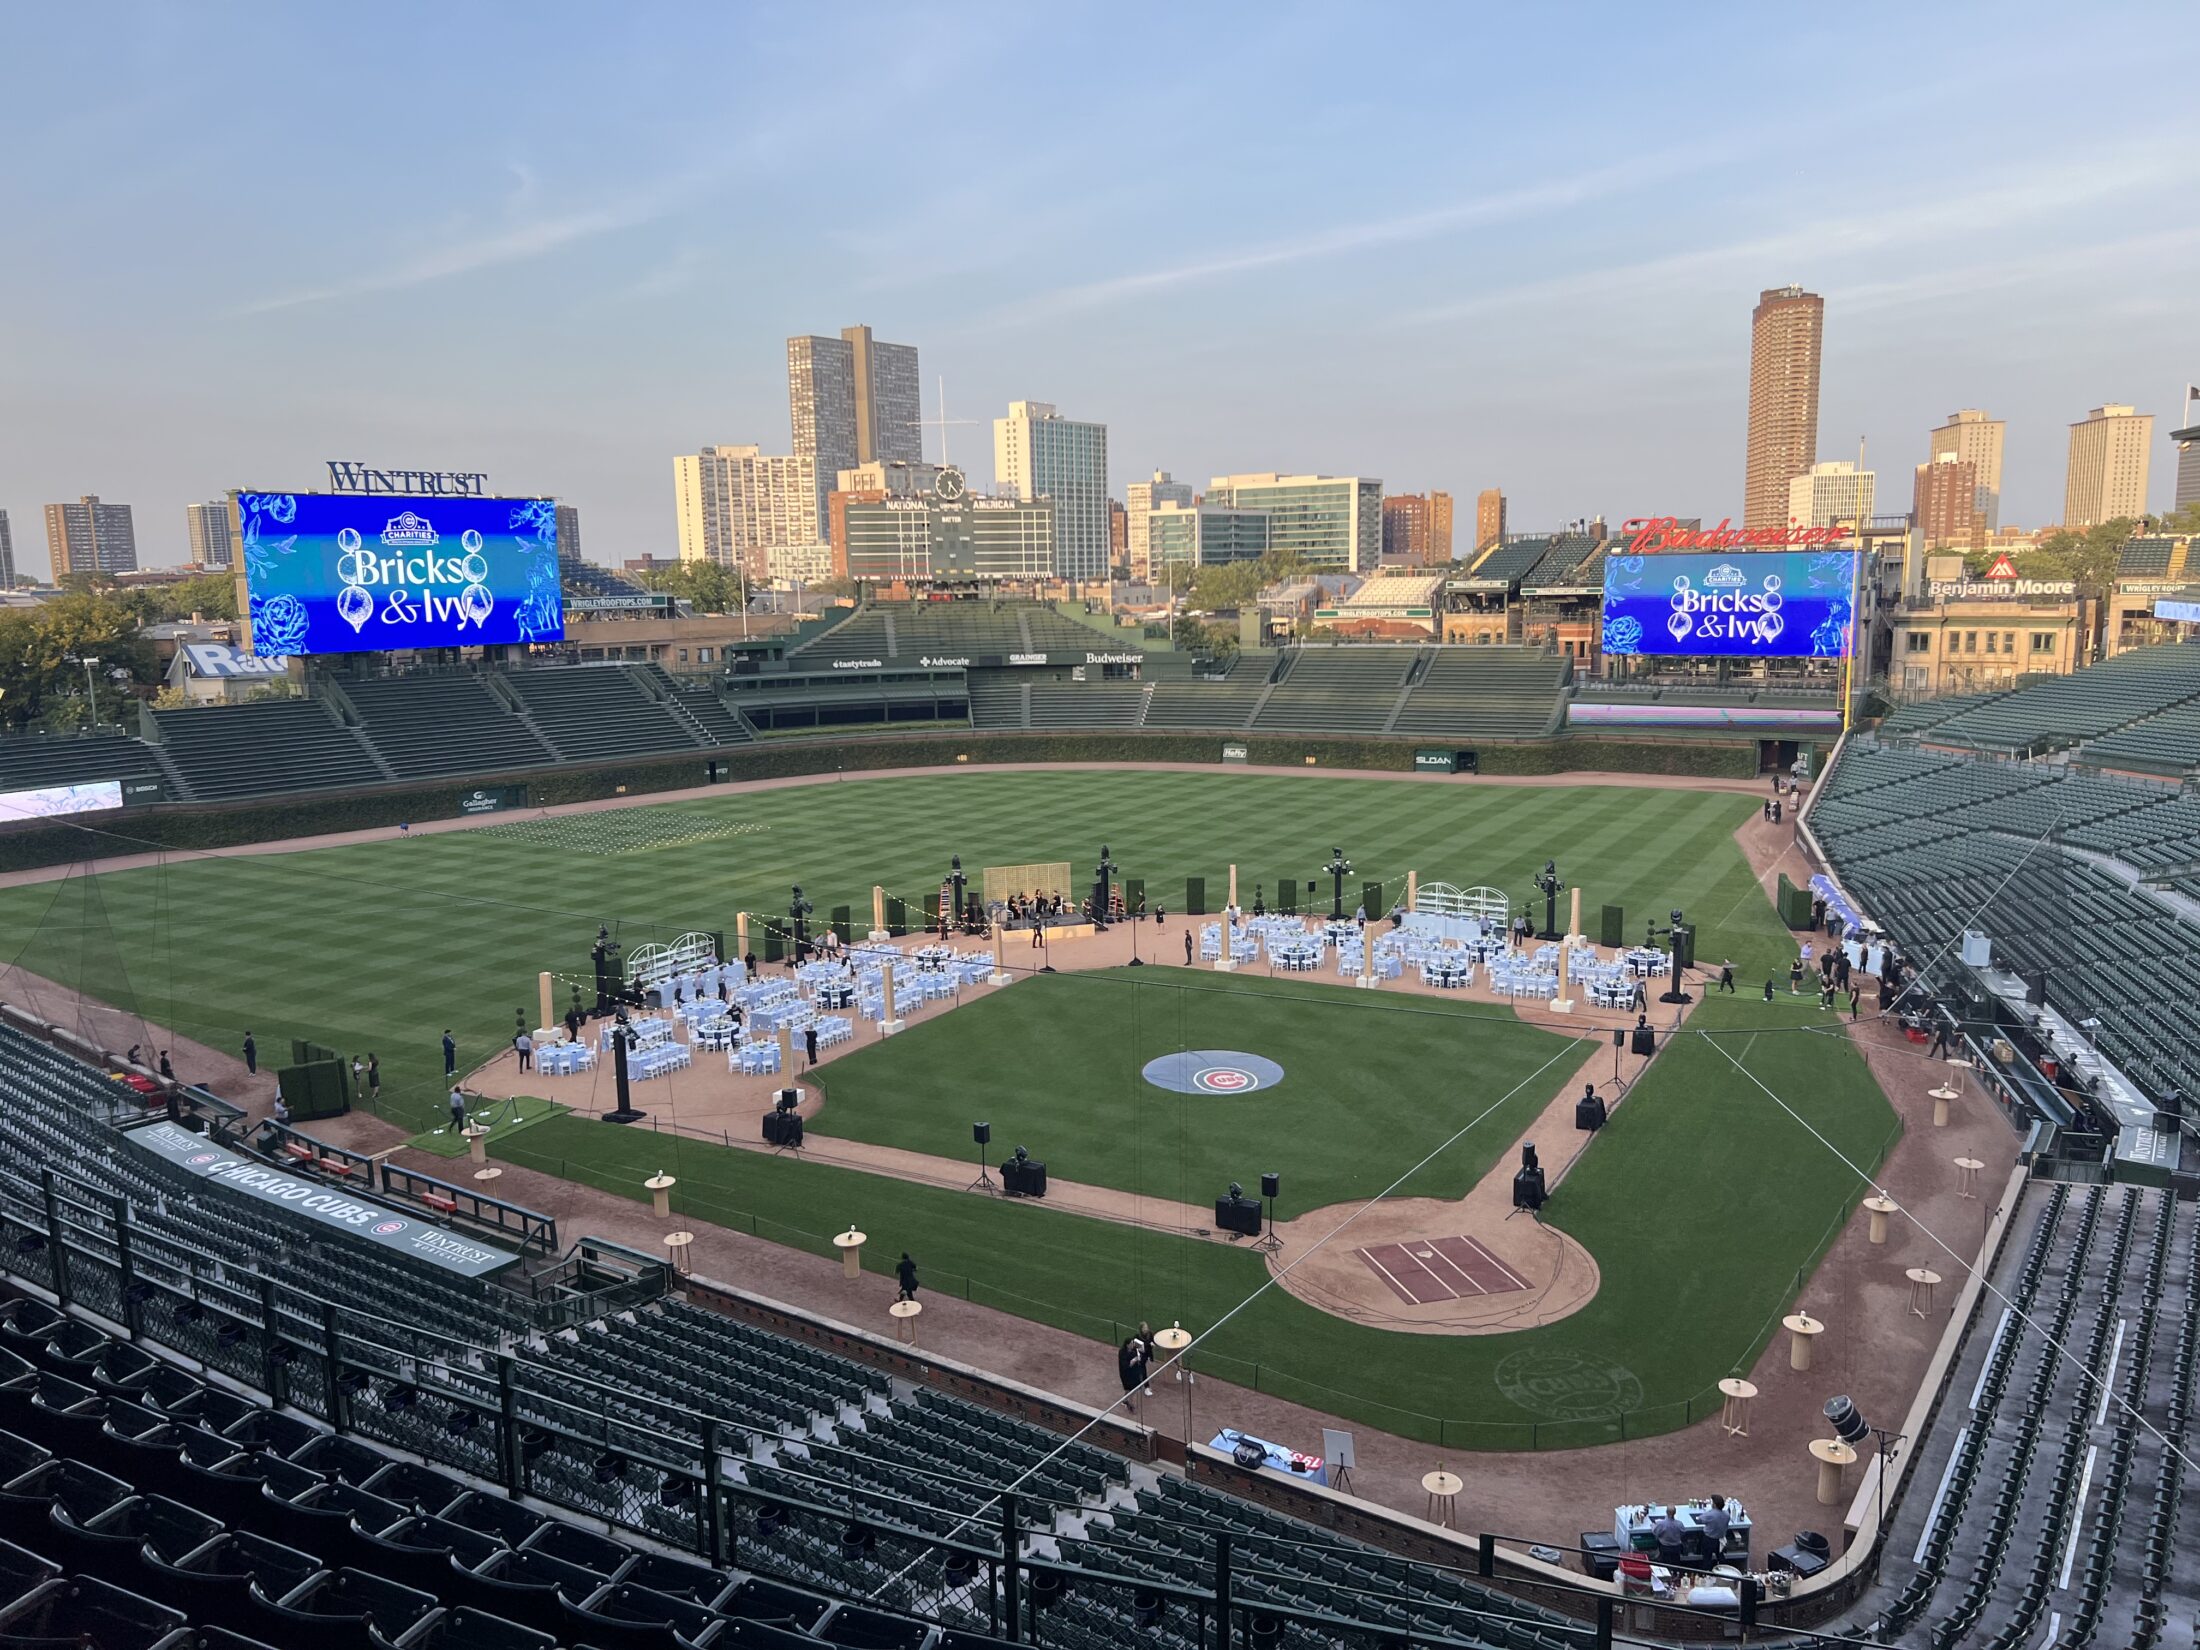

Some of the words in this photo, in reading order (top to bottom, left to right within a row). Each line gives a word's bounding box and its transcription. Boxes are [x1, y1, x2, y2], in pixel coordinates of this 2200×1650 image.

[326, 461, 488, 496] WINTRUST
[886, 500, 930, 510] NATIONAL
[973, 500, 1015, 510] AMERICAN
[387, 531, 432, 539] CHARITIES
[1621, 516, 1852, 553] Budweiser
[354, 549, 465, 585] Bricks
[1930, 579, 2011, 598] Benjamin
[2015, 579, 2074, 595] Moore
[570, 597, 653, 608] WRIGLEYROOFTOPS.COM
[1683, 588, 1763, 613] Bricks
[931, 657, 970, 667] Advocate
[1009, 653, 1047, 661] GRAINGER
[1086, 652, 1143, 664] Budweiser
[838, 658, 882, 669] tastytrade
[1415, 756, 1452, 765] SLOAN
[135, 784, 158, 793] BOSCH
[462, 798, 497, 807] Gallagher
[154, 1125, 203, 1152] WINTRUST
[207, 1161, 313, 1200] CHICAGO
[418, 1230, 496, 1262] WINTRUST
